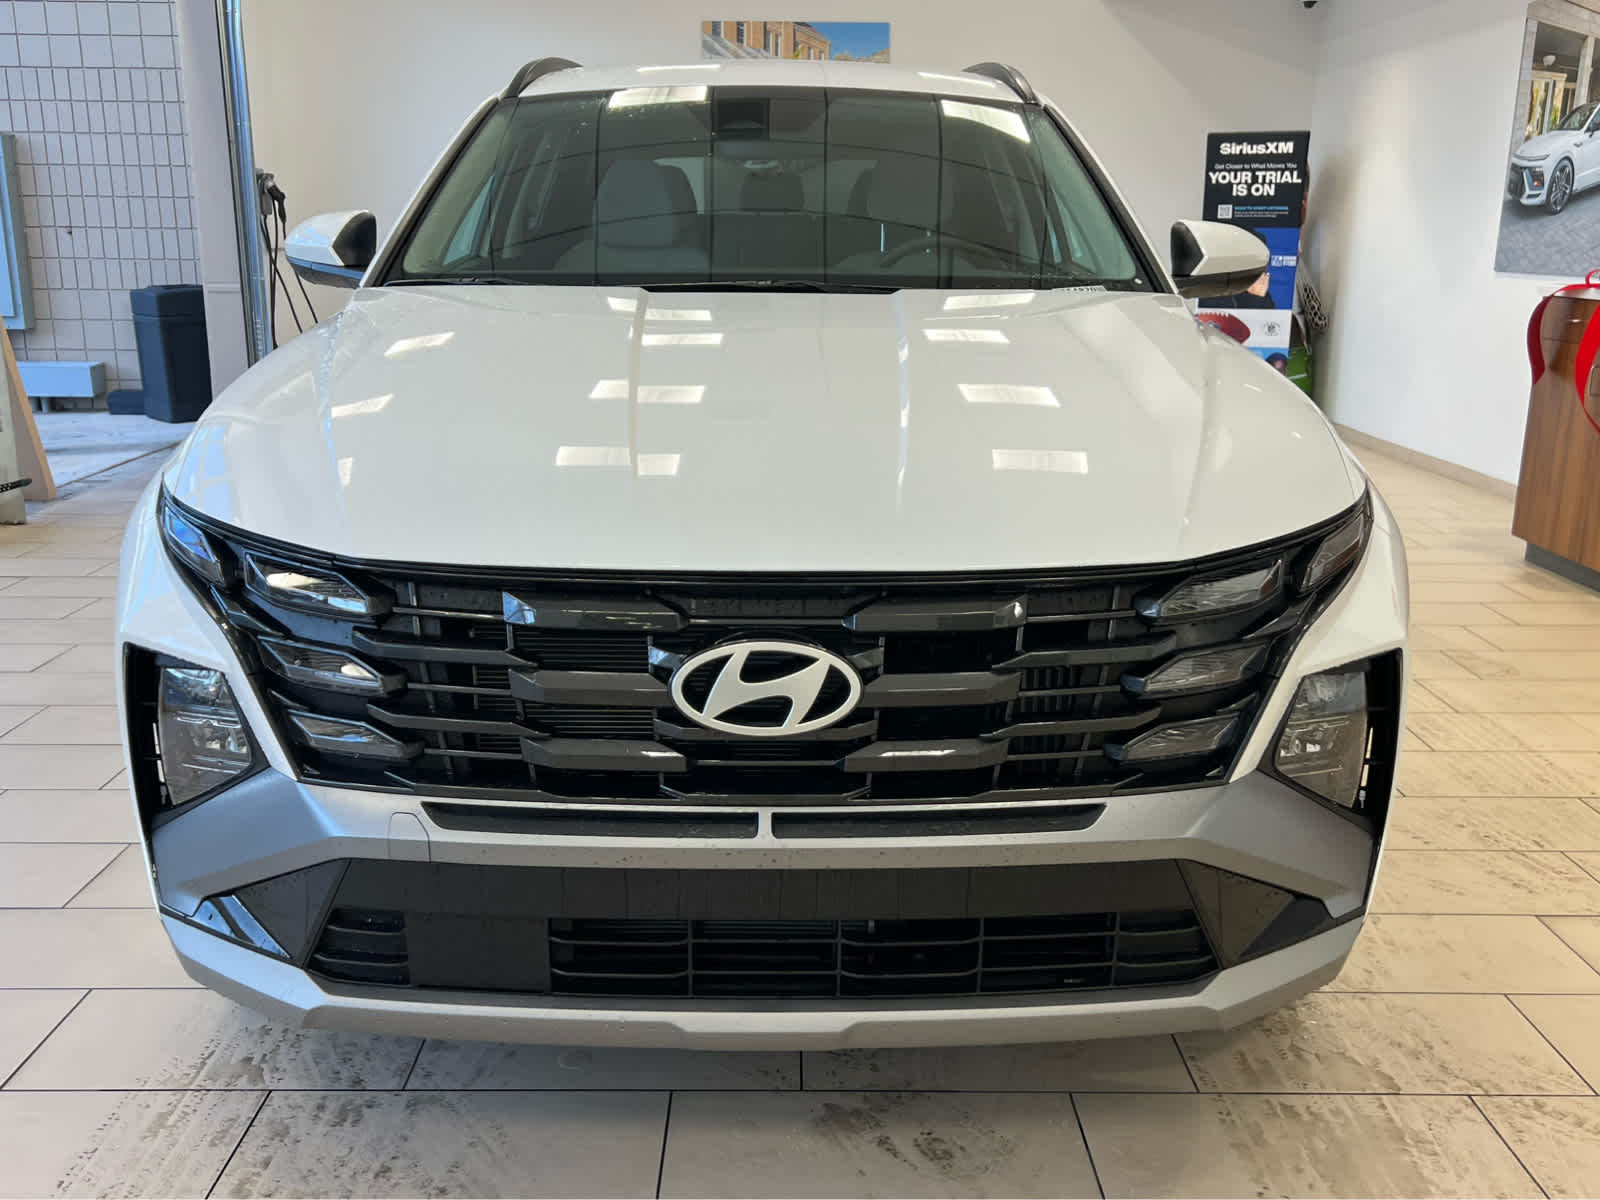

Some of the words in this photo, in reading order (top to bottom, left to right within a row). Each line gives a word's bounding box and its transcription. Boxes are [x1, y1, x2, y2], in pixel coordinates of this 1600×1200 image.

[1219, 141, 1294, 154] SiriusXM
[1208, 171, 1252, 184] YOUR
[1255, 170, 1302, 184] TRIAL
[1232, 183, 1247, 196] IS
[1250, 183, 1275, 196] ON
